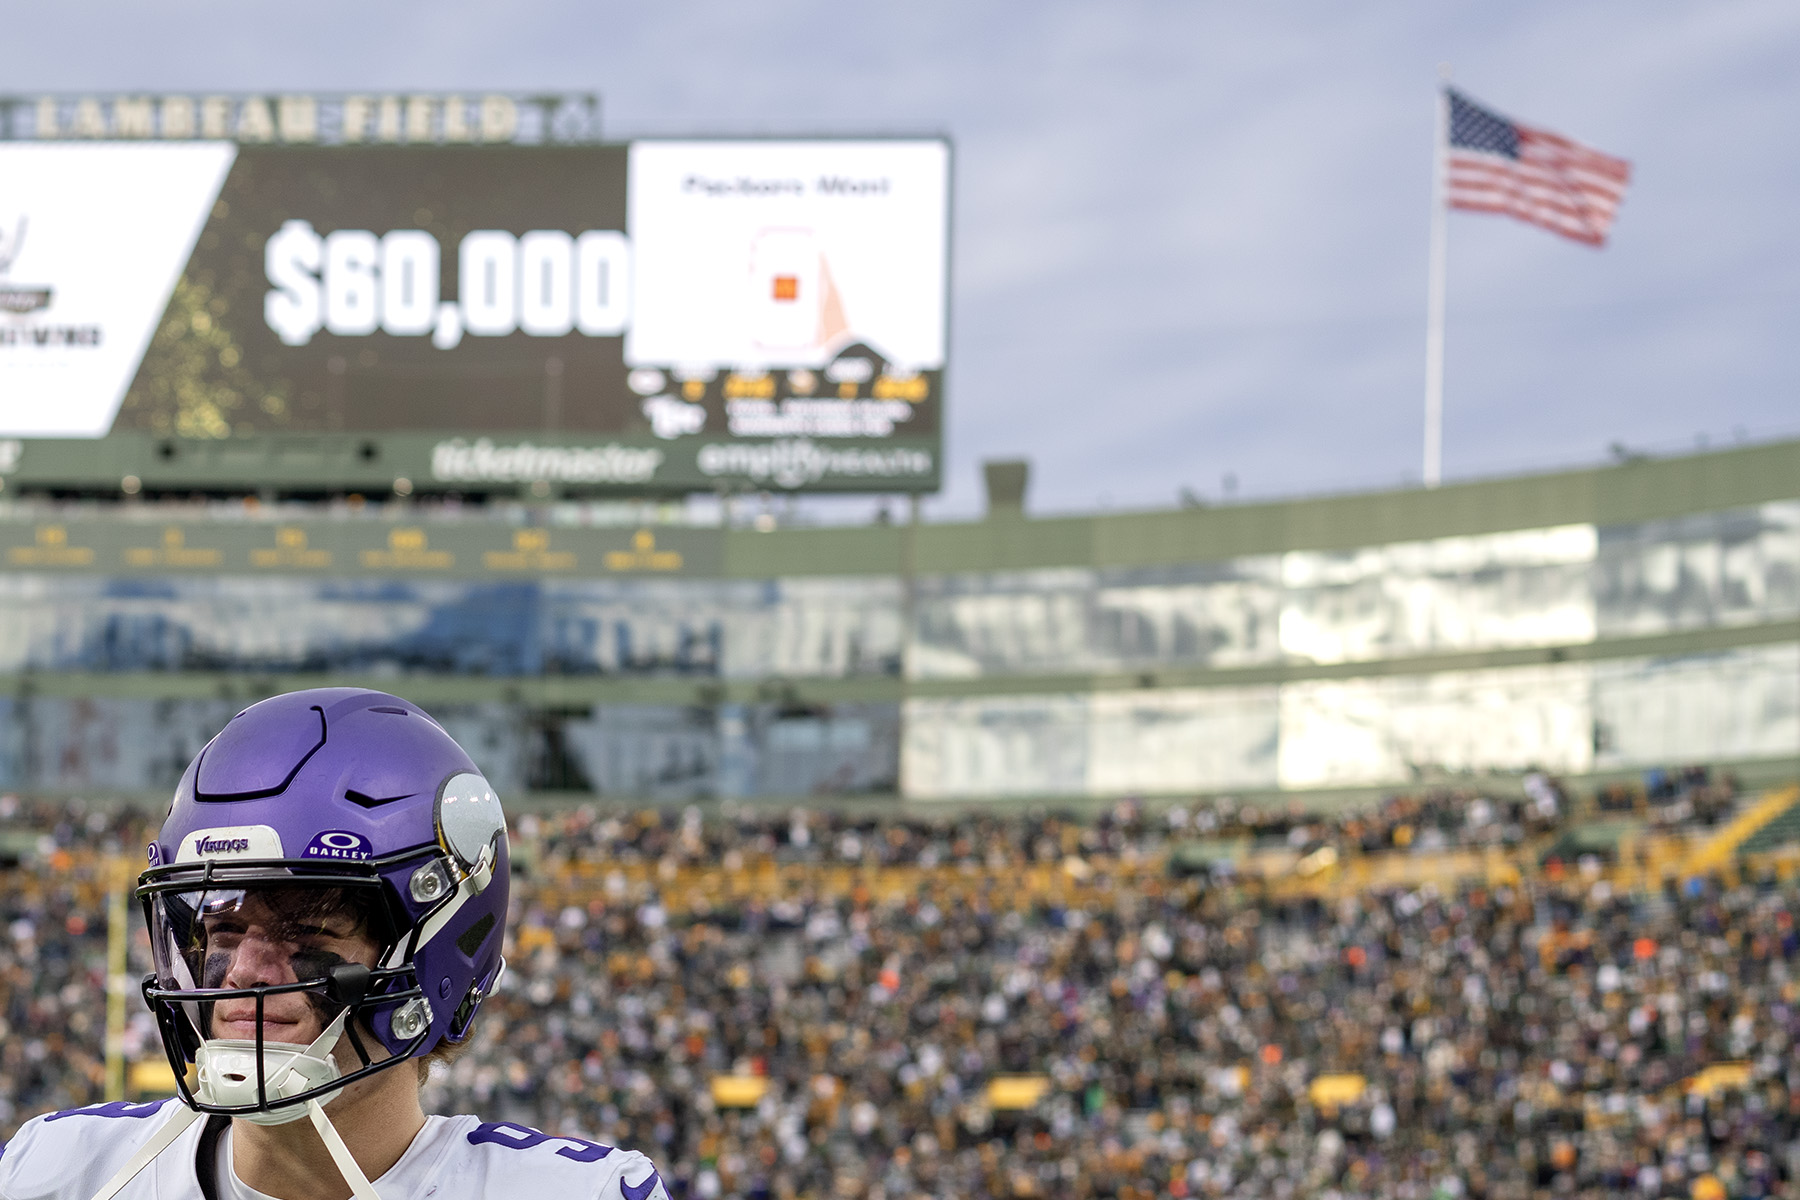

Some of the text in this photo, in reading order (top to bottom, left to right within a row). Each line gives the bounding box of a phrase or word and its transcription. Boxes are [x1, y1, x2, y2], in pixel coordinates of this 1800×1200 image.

[36, 96, 516, 141] LAMBEAU FIELD
[264, 219, 632, 350] $60,000
[433, 440, 662, 480] ticketmaster
[309, 846, 369, 860] OAKLEY
[466, 1121, 615, 1163] 9
